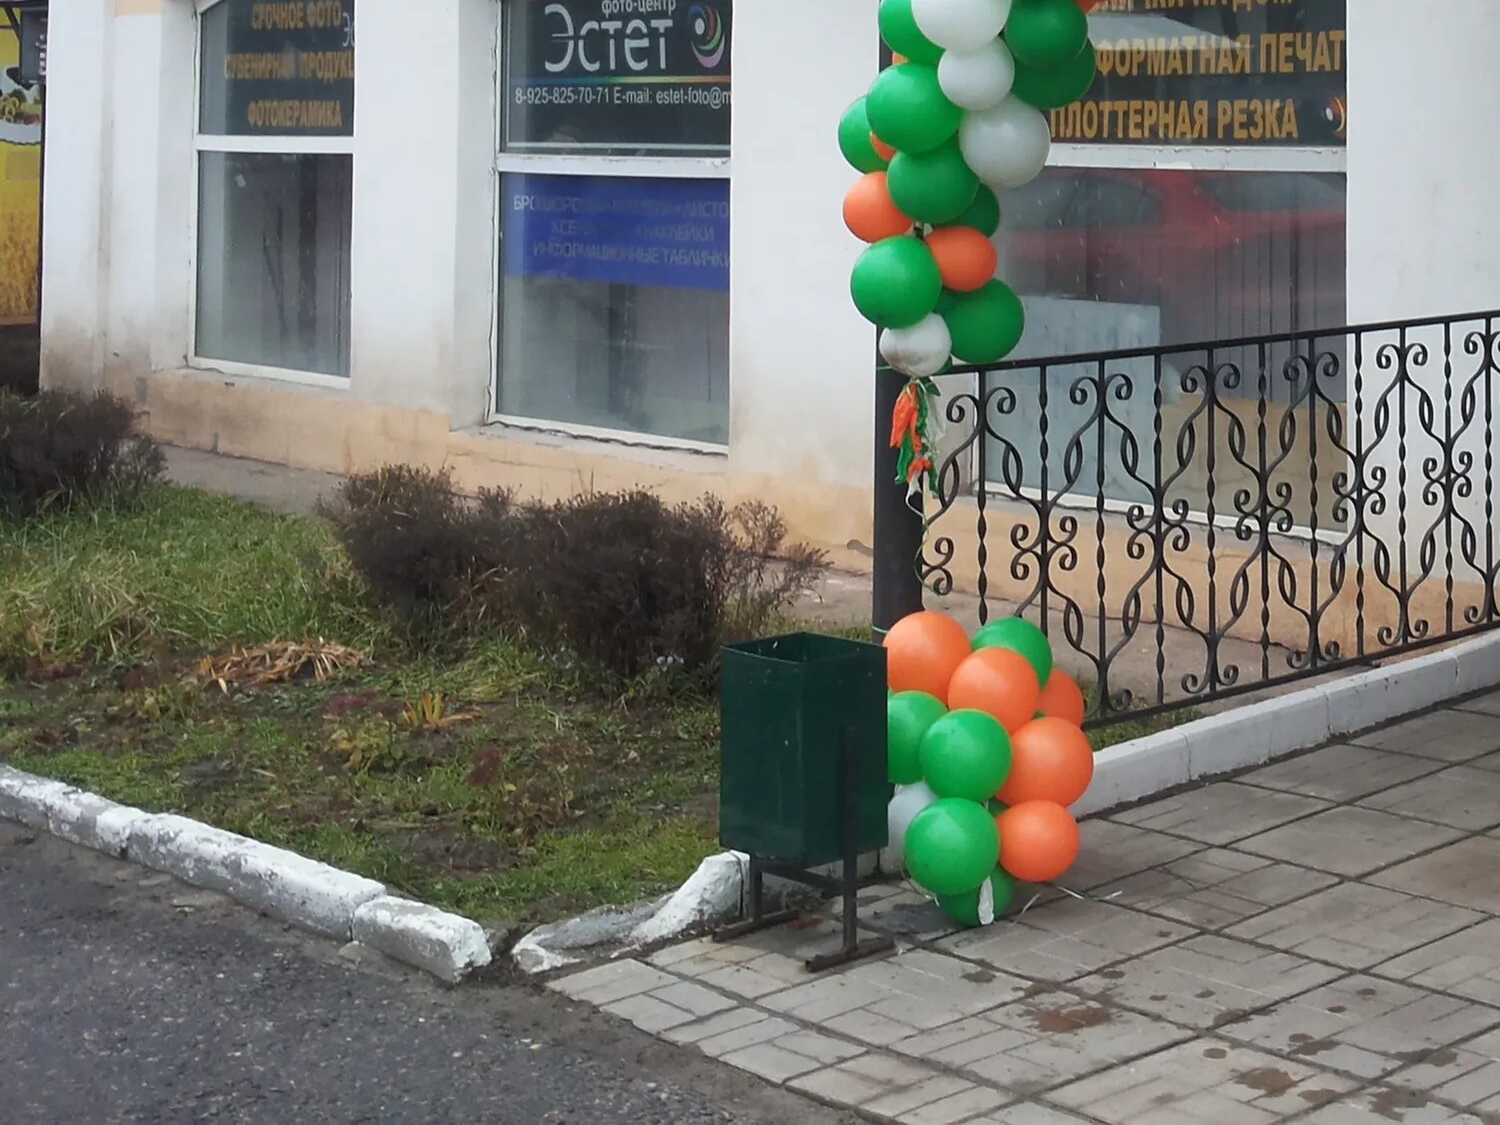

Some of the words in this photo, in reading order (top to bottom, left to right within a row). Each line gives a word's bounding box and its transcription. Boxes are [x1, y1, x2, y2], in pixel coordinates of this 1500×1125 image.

[251, 1, 304, 30] СРОЧНОЕ
[306, 0, 342, 28] ФОТО
[544, 2, 674, 73] Эстет
[1096, 33, 1251, 77] ФОРМАТНАЯ
[1259, 29, 1346, 75] ПЕЧАТ
[247, 100, 342, 128] ФОТОКЕРАМИКА
[514, 85, 610, 105] 8-925-825-70-71
[656, 86, 731, 109] estet-foto@m
[1050, 98, 1209, 141] ПЛОТТЕРНАЯ
[1216, 98, 1299, 141] РЕЗКА
